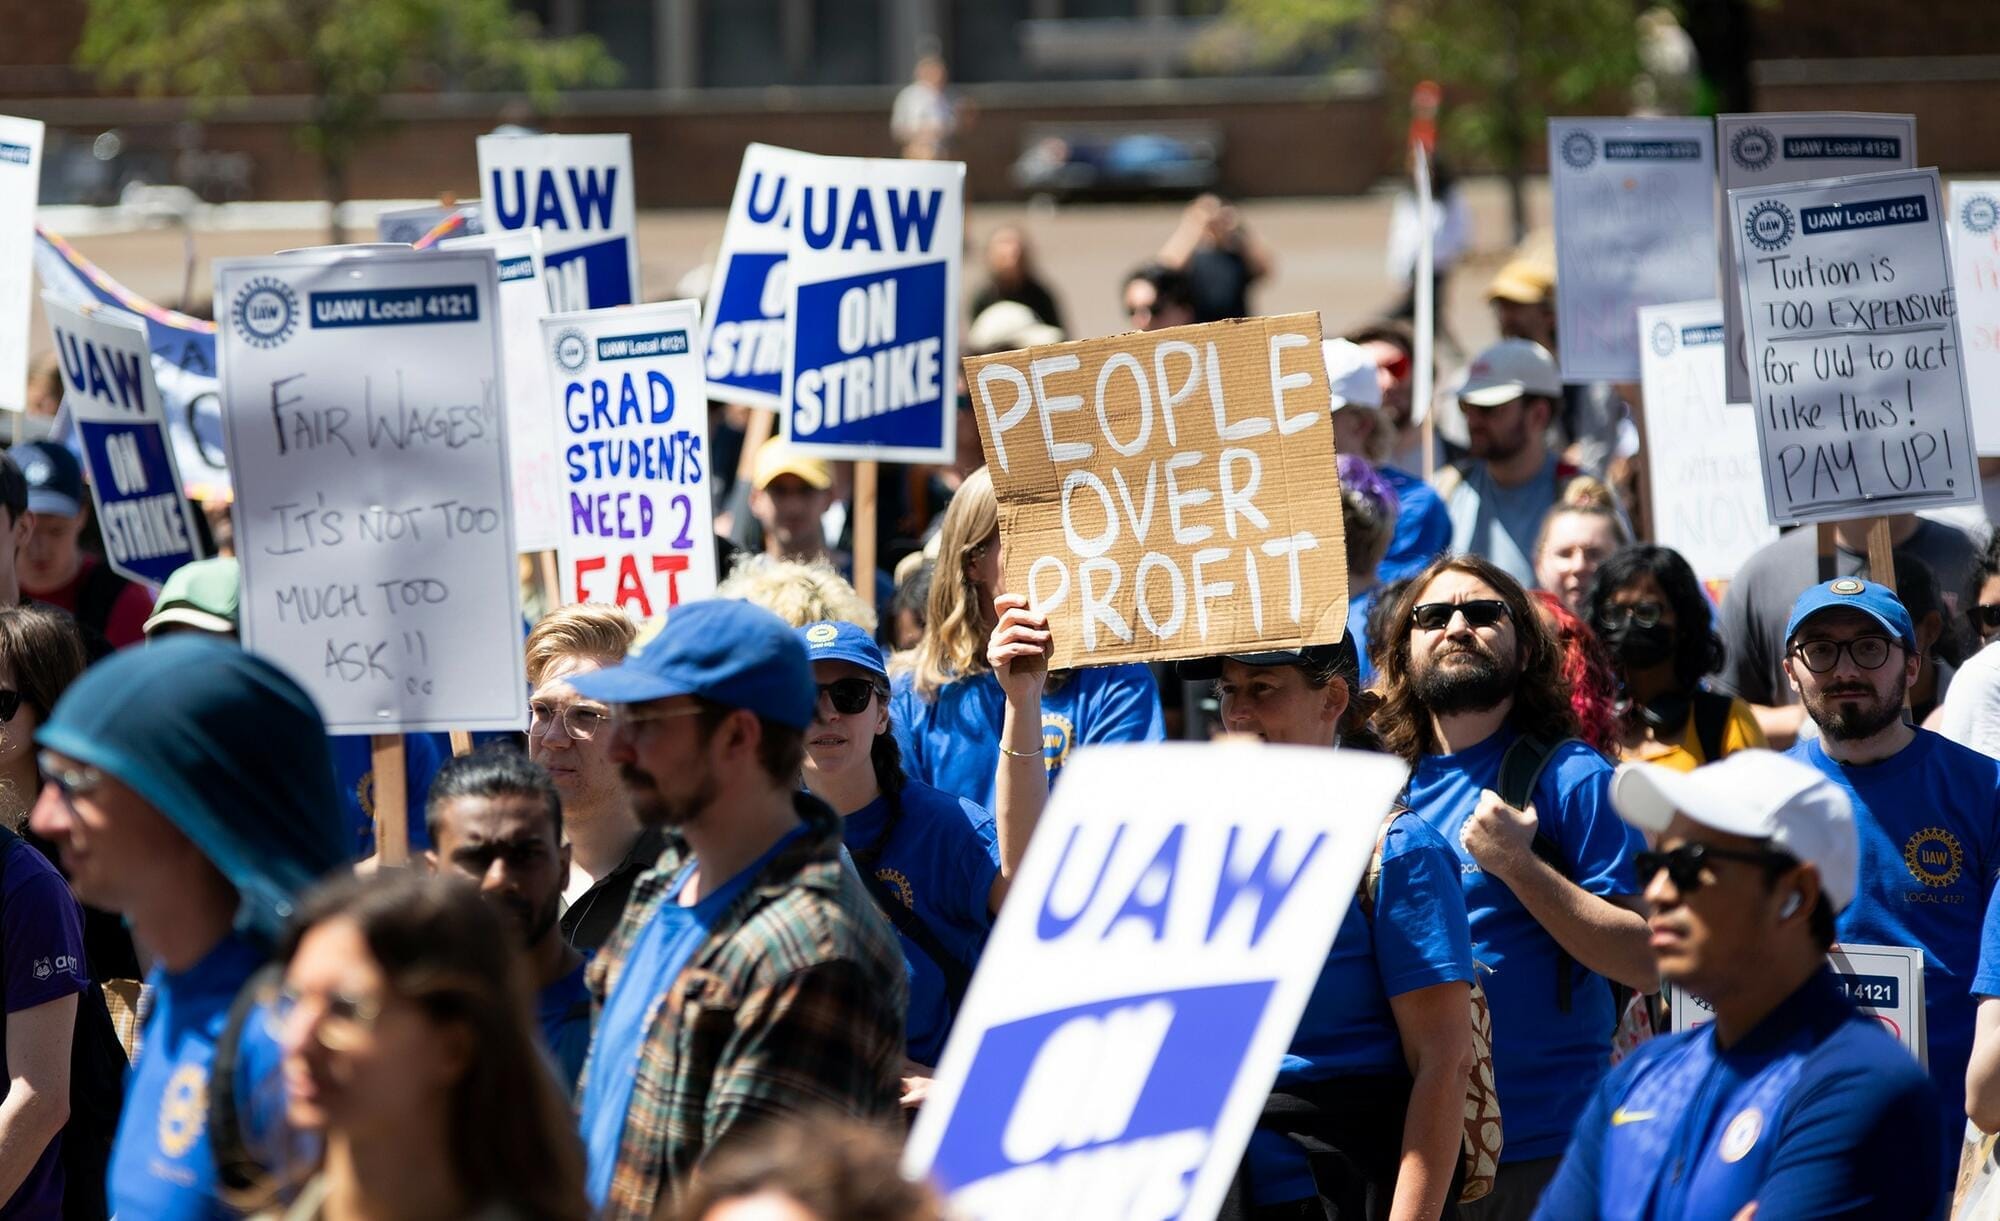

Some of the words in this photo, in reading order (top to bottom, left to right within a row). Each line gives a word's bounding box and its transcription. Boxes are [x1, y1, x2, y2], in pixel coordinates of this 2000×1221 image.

[1788, 140, 1822, 157] UAW
[1824, 140, 1863, 156] Local
[1865, 140, 1896, 157] 4121
[491, 167, 618, 230] UAW
[802, 186, 943, 253] UAW
[1758, 221, 1780, 232] UAW
[1807, 211, 1843, 230] UAW
[1846, 207, 1886, 225] Local
[1888, 202, 1922, 219] 4121
[1757, 255, 1860, 290] Tuition
[1871, 254, 1895, 283] is
[252, 303, 279, 320] UAW
[315, 298, 366, 322] UAW
[368, 295, 424, 320] Local
[425, 293, 473, 317] 4121
[837, 277, 898, 355] ON
[1761, 300, 1814, 330] TOO
[1828, 286, 1958, 331] EXPENSIVE
[54, 325, 146, 416] UAW
[793, 336, 941, 437] STRIKE
[1760, 345, 1800, 385] for
[1814, 343, 1855, 382] UW
[1866, 342, 1894, 371] to
[1905, 338, 1955, 371] act
[270, 373, 355, 457] FAIR
[565, 370, 675, 434] GRAD
[976, 332, 1320, 475] PEOPLE
[1768, 394, 1826, 432] like
[1838, 378, 1916, 432] this!
[104, 431, 149, 496] ON
[566, 430, 703, 485] STUDENTS
[1777, 438, 1864, 502] PAY
[1881, 428, 1955, 491] UP!
[102, 490, 193, 564] STRIKE
[265, 491, 344, 556] IT'S
[358, 506, 423, 543] NOT
[430, 500, 499, 540] TOO
[570, 491, 654, 539] NEED
[670, 493, 695, 549] 2
[1061, 447, 1271, 558] OVER
[275, 583, 368, 625] MUCH
[375, 577, 449, 615] TOO
[1027, 530, 1320, 653] PROFIT
[1036, 821, 1331, 950] UAW
[1921, 849, 1948, 866] UAW
[1903, 891, 1940, 904] LOCAL
[1854, 984, 1892, 1001] 4121
